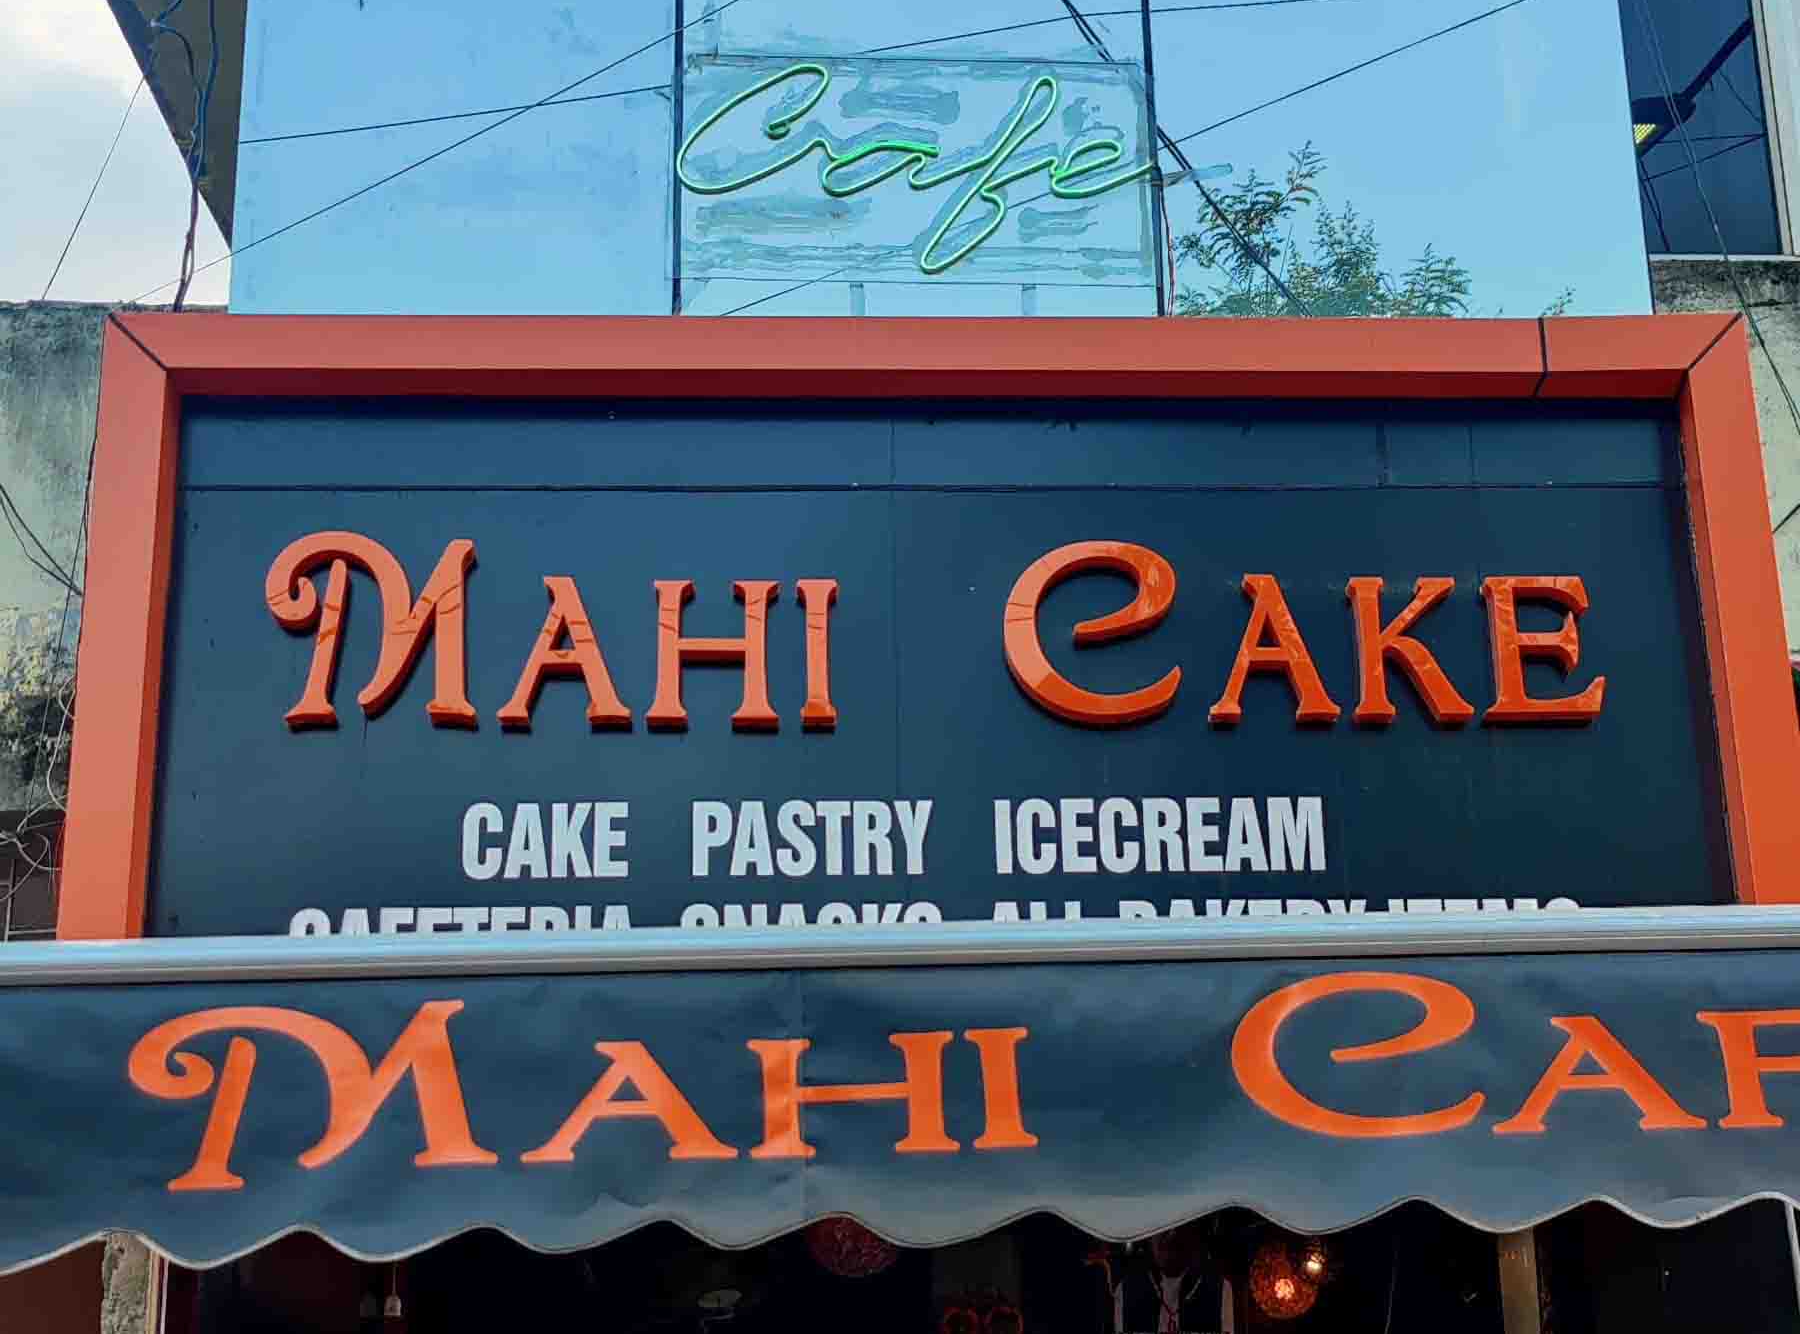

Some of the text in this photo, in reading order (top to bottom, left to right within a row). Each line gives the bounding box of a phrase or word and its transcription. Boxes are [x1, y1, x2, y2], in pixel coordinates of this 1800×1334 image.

[676, 62, 1155, 275] Cafe
[266, 531, 1606, 729] MAHI CAKE
[462, 796, 1327, 880] CAKE PASTRY ICECREAM
[128, 999, 1040, 1193] MAHI
